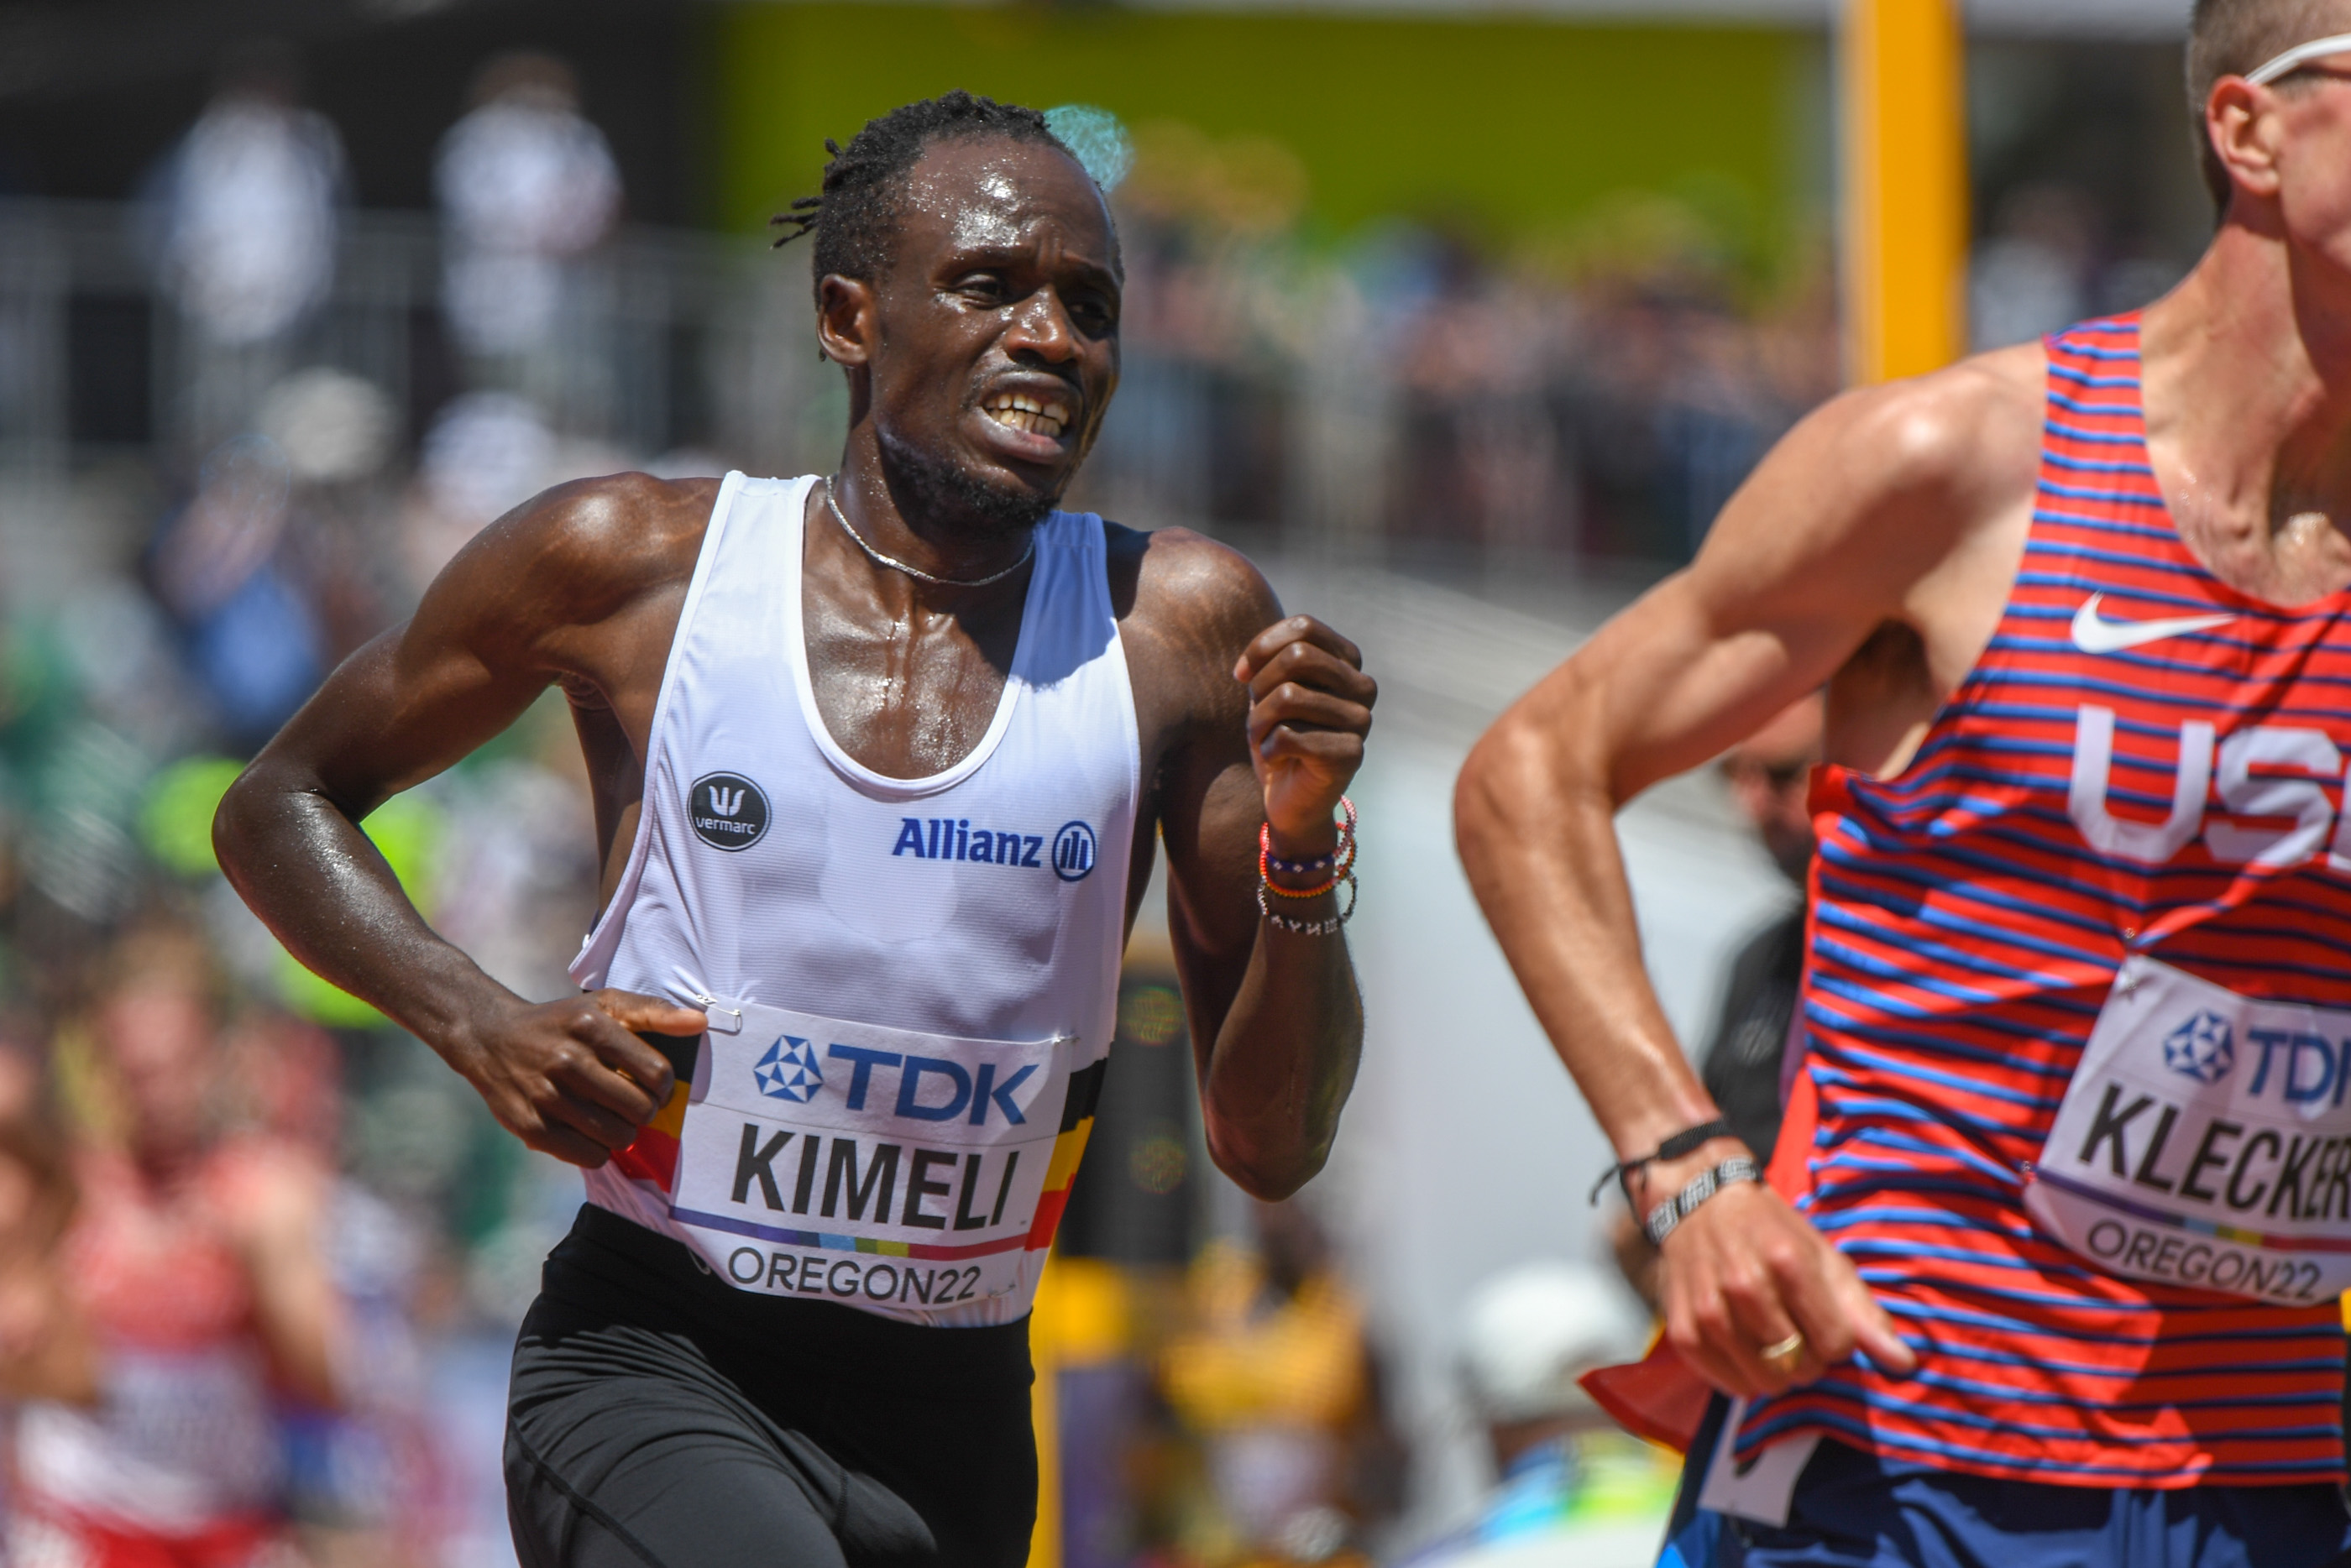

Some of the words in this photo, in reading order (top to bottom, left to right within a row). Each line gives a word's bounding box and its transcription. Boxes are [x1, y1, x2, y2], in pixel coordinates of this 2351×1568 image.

[694, 816, 757, 835] vermarc
[2067, 703, 2351, 871] US
[892, 817, 1044, 868] Allianz
[828, 1043, 1039, 1126] TDK
[730, 1122, 1021, 1231] KIMELI
[727, 1246, 982, 1304] OREGON22
[2087, 1220, 2322, 1299] OREGON22
